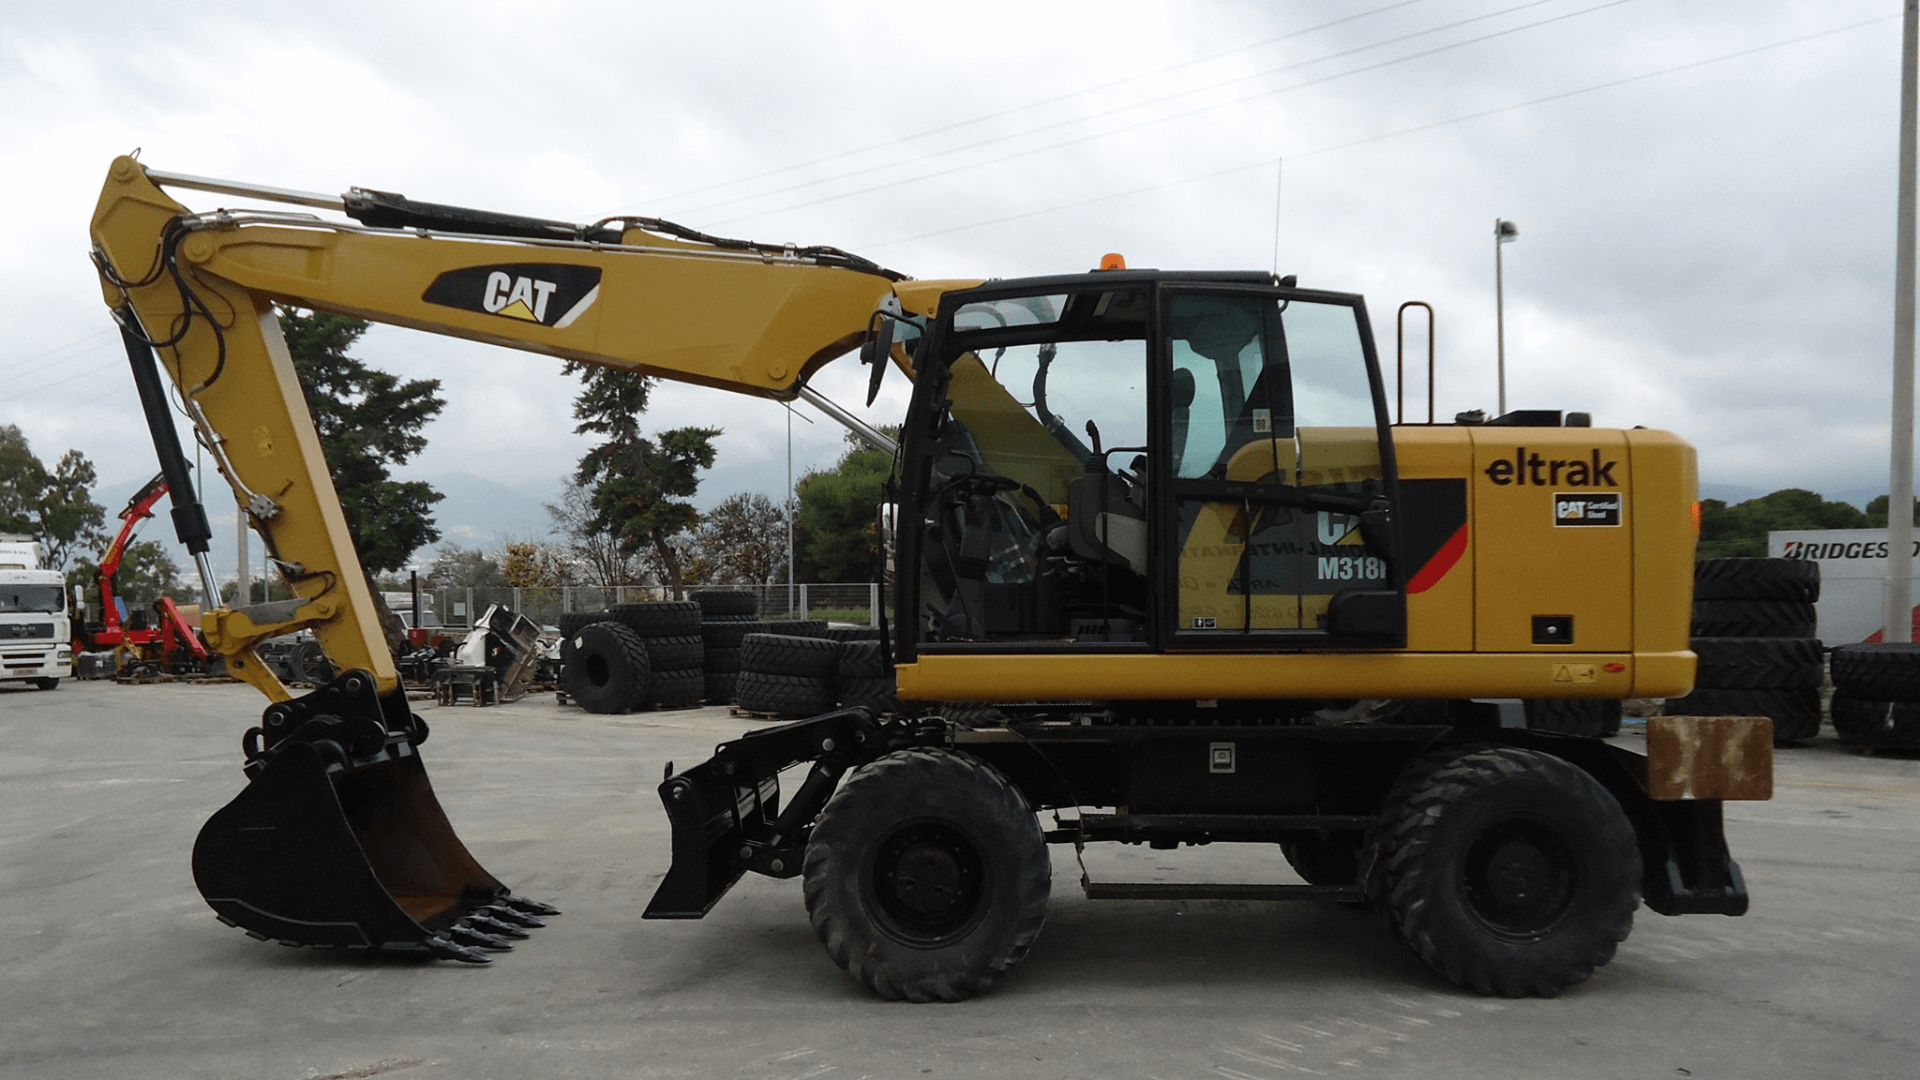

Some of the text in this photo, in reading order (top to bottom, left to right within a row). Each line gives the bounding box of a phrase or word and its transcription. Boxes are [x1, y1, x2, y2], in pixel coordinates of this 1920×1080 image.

[483, 271, 556, 323] CAT
[1485, 447, 1618, 486] eltrak
[1557, 501, 1586, 519] CAT
[1784, 541, 1920, 559] BRIDGES
